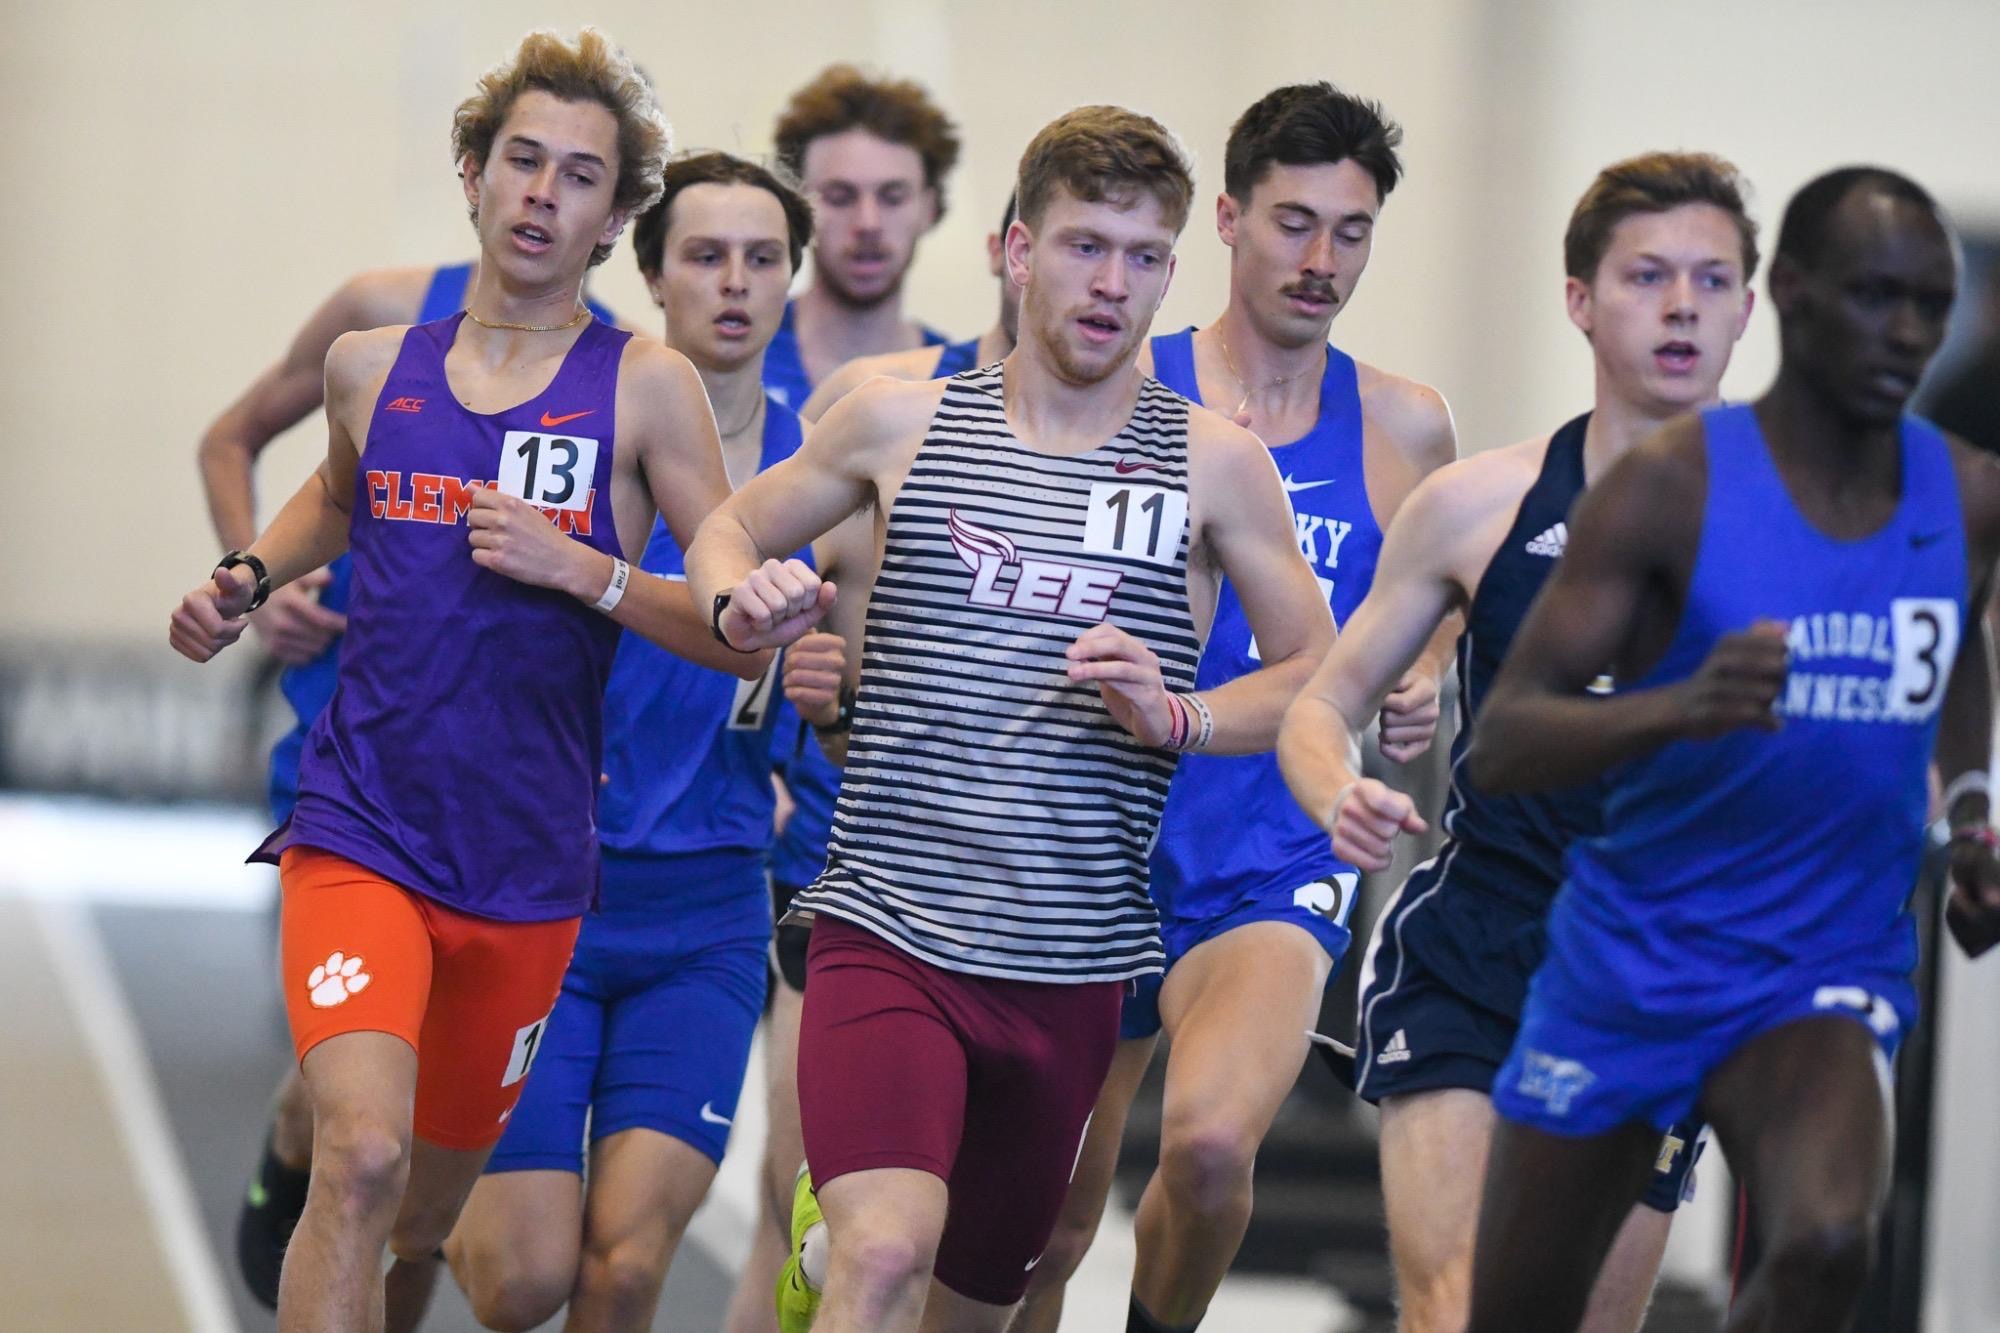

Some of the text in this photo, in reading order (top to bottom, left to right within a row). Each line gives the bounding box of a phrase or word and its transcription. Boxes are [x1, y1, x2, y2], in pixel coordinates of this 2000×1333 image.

[386, 397, 426, 411] ACC
[366, 470, 596, 536] CLEMN
[517, 436, 579, 504] 13
[1106, 489, 1165, 557] 11
[966, 552, 1124, 622] LEE
[1785, 611, 1891, 662] MIDDL
[1906, 611, 1941, 705] 3
[520, 1023, 541, 1076] 1
